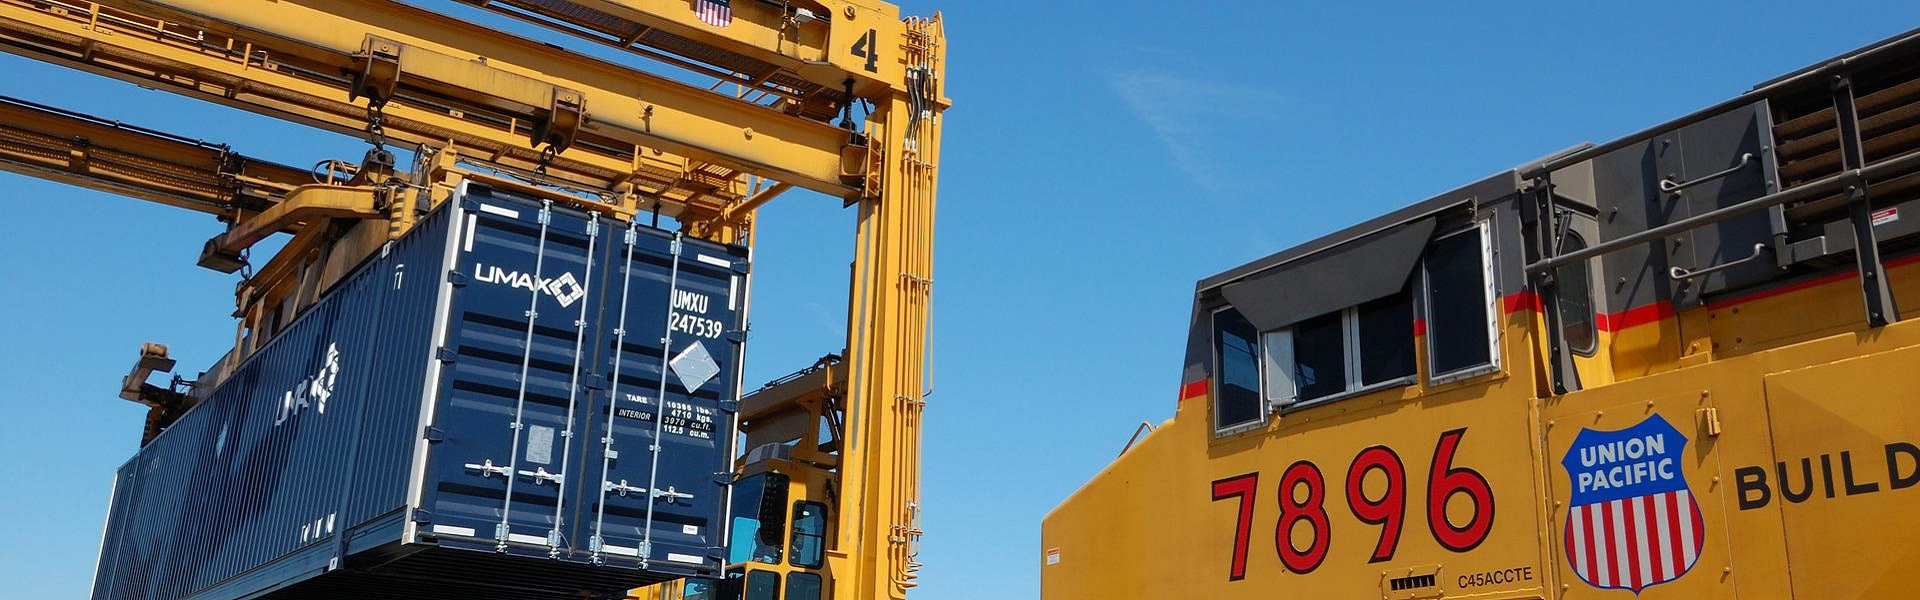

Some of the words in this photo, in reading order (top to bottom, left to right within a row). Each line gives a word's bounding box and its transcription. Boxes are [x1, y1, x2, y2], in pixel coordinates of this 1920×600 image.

[851, 28, 878, 73] 4
[475, 263, 552, 295] UMAX
[673, 289, 709, 314] UMXU
[670, 312, 722, 339] 247539
[626, 394, 648, 404] TARE
[618, 408, 651, 421] INTERIOR
[664, 416, 686, 427] 3970
[690, 422, 711, 431] cu.ft.
[671, 409, 692, 420] 4710
[696, 413, 713, 423] kgs.
[663, 424, 684, 435] 112.5
[689, 430, 710, 439] cu.m.
[1580, 433, 1666, 468] UNION
[1578, 458, 1674, 493] PACIFIC
[1734, 442, 1920, 511] BUILD
[1211, 427, 1496, 581] 7896
[1458, 566, 1533, 589] C45ACCTE
